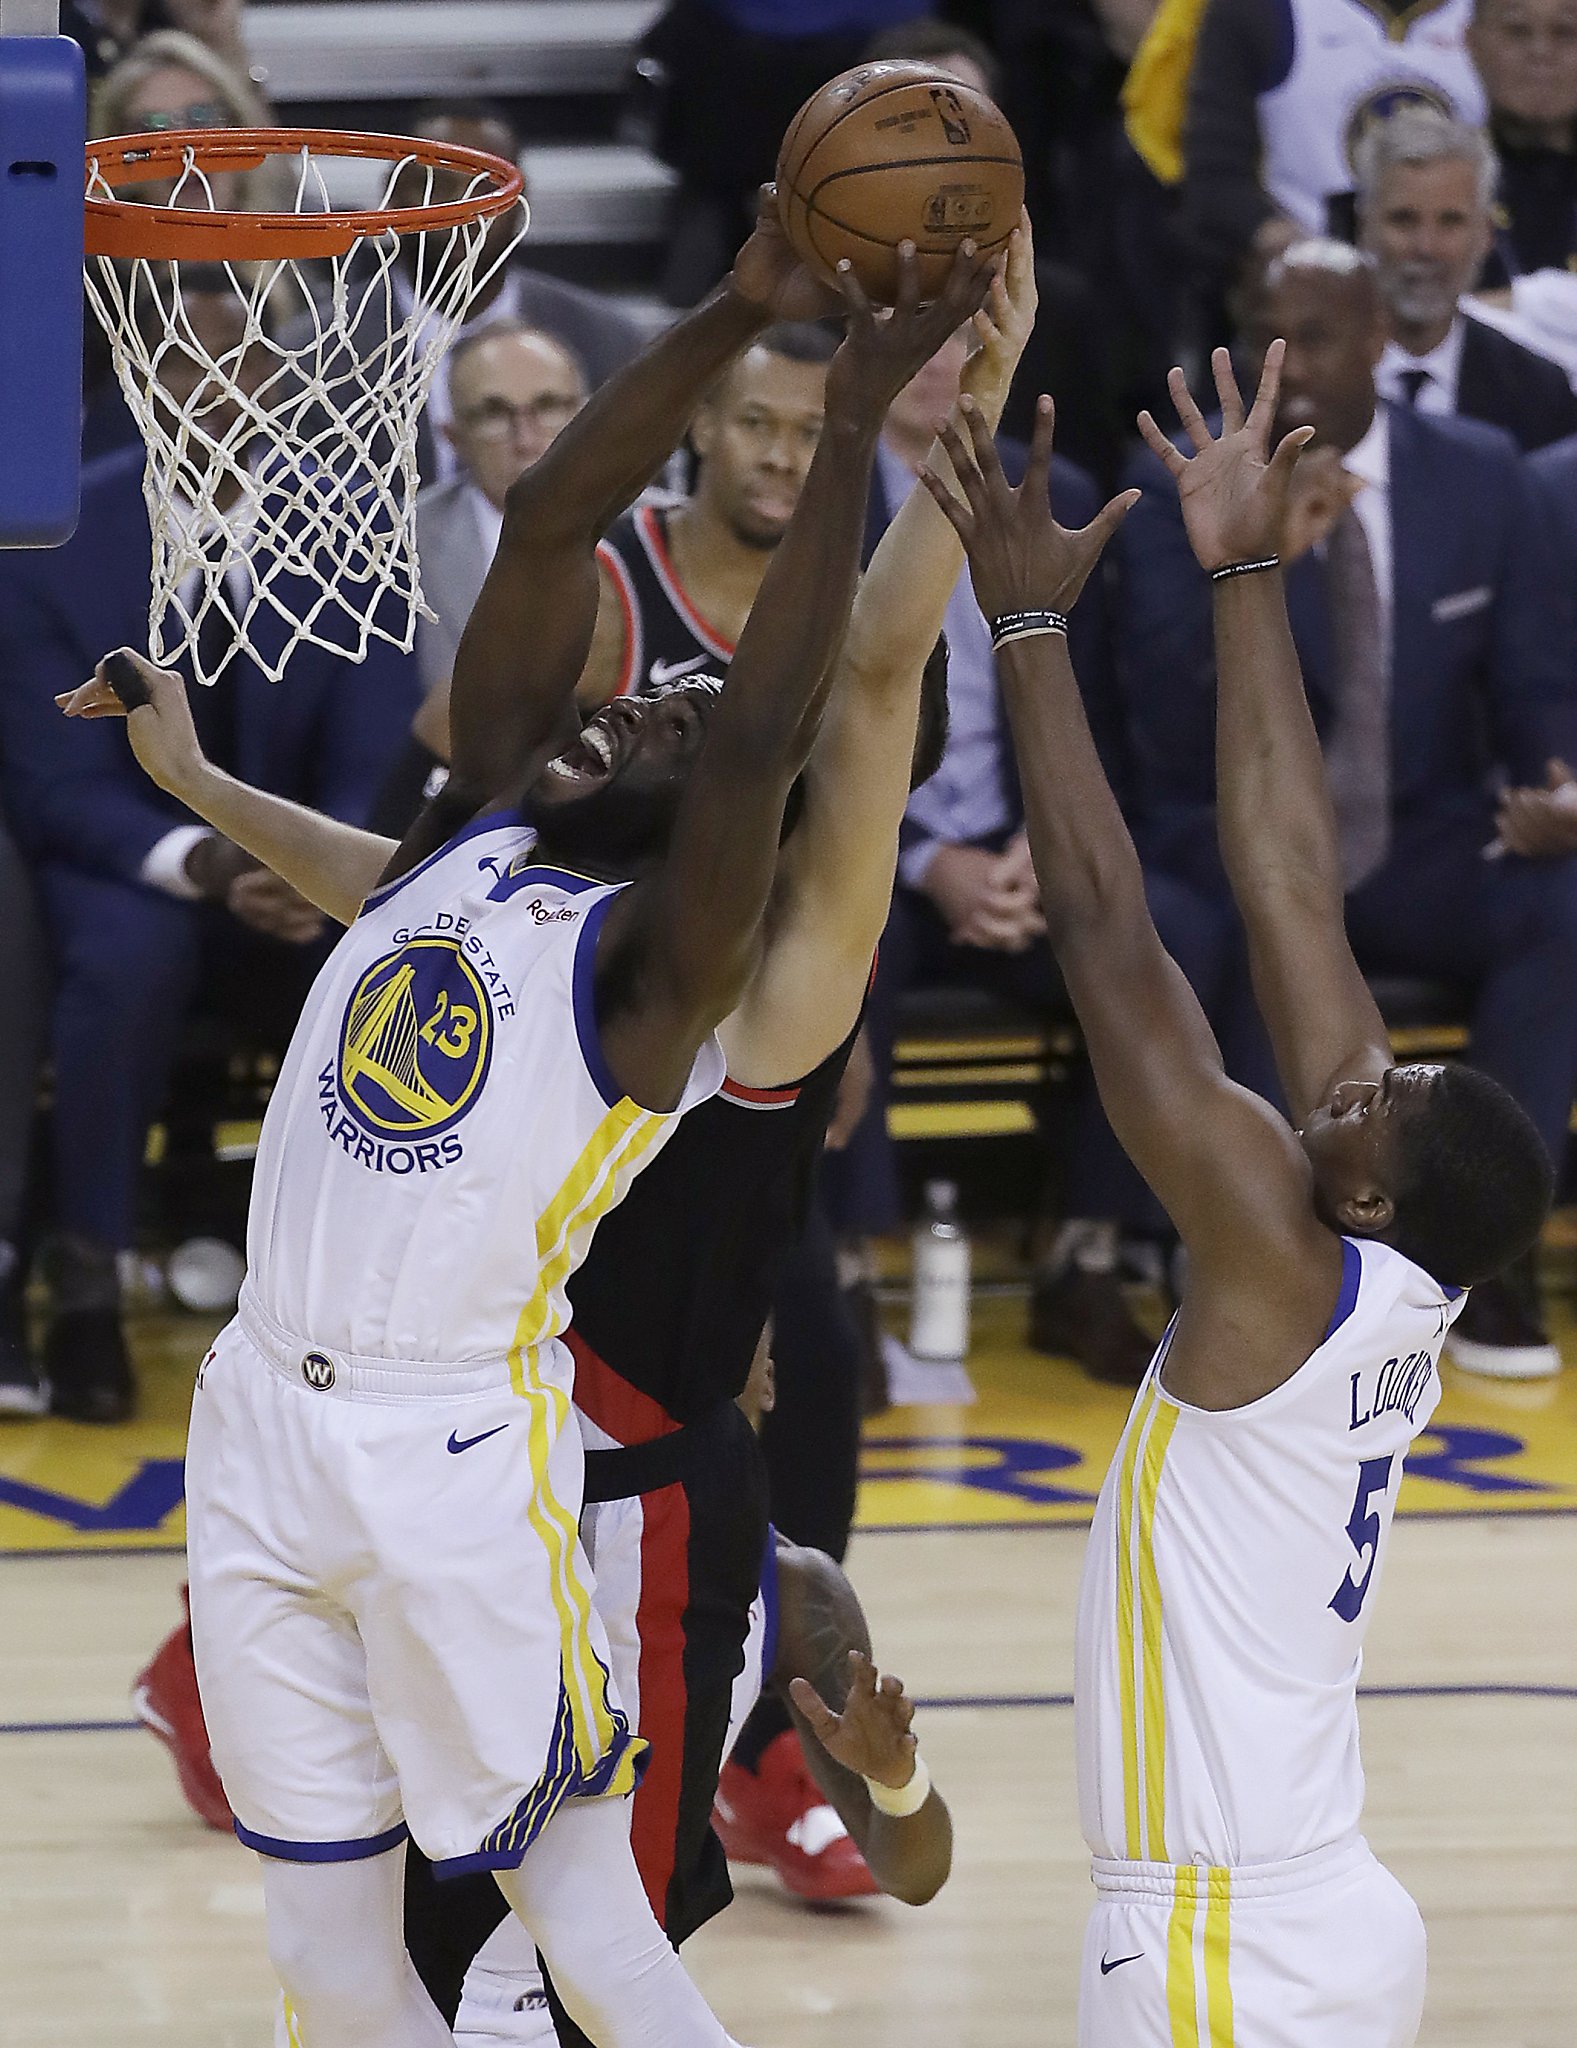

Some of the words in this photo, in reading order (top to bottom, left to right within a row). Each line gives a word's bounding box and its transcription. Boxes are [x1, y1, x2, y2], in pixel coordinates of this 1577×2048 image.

[465, 936, 516, 1022] STATE
[418, 990, 477, 1059] 23
[317, 1057, 464, 1175] WARRIORS
[305, 1359, 331, 1385] W
[1327, 1452, 1394, 1623] 5
